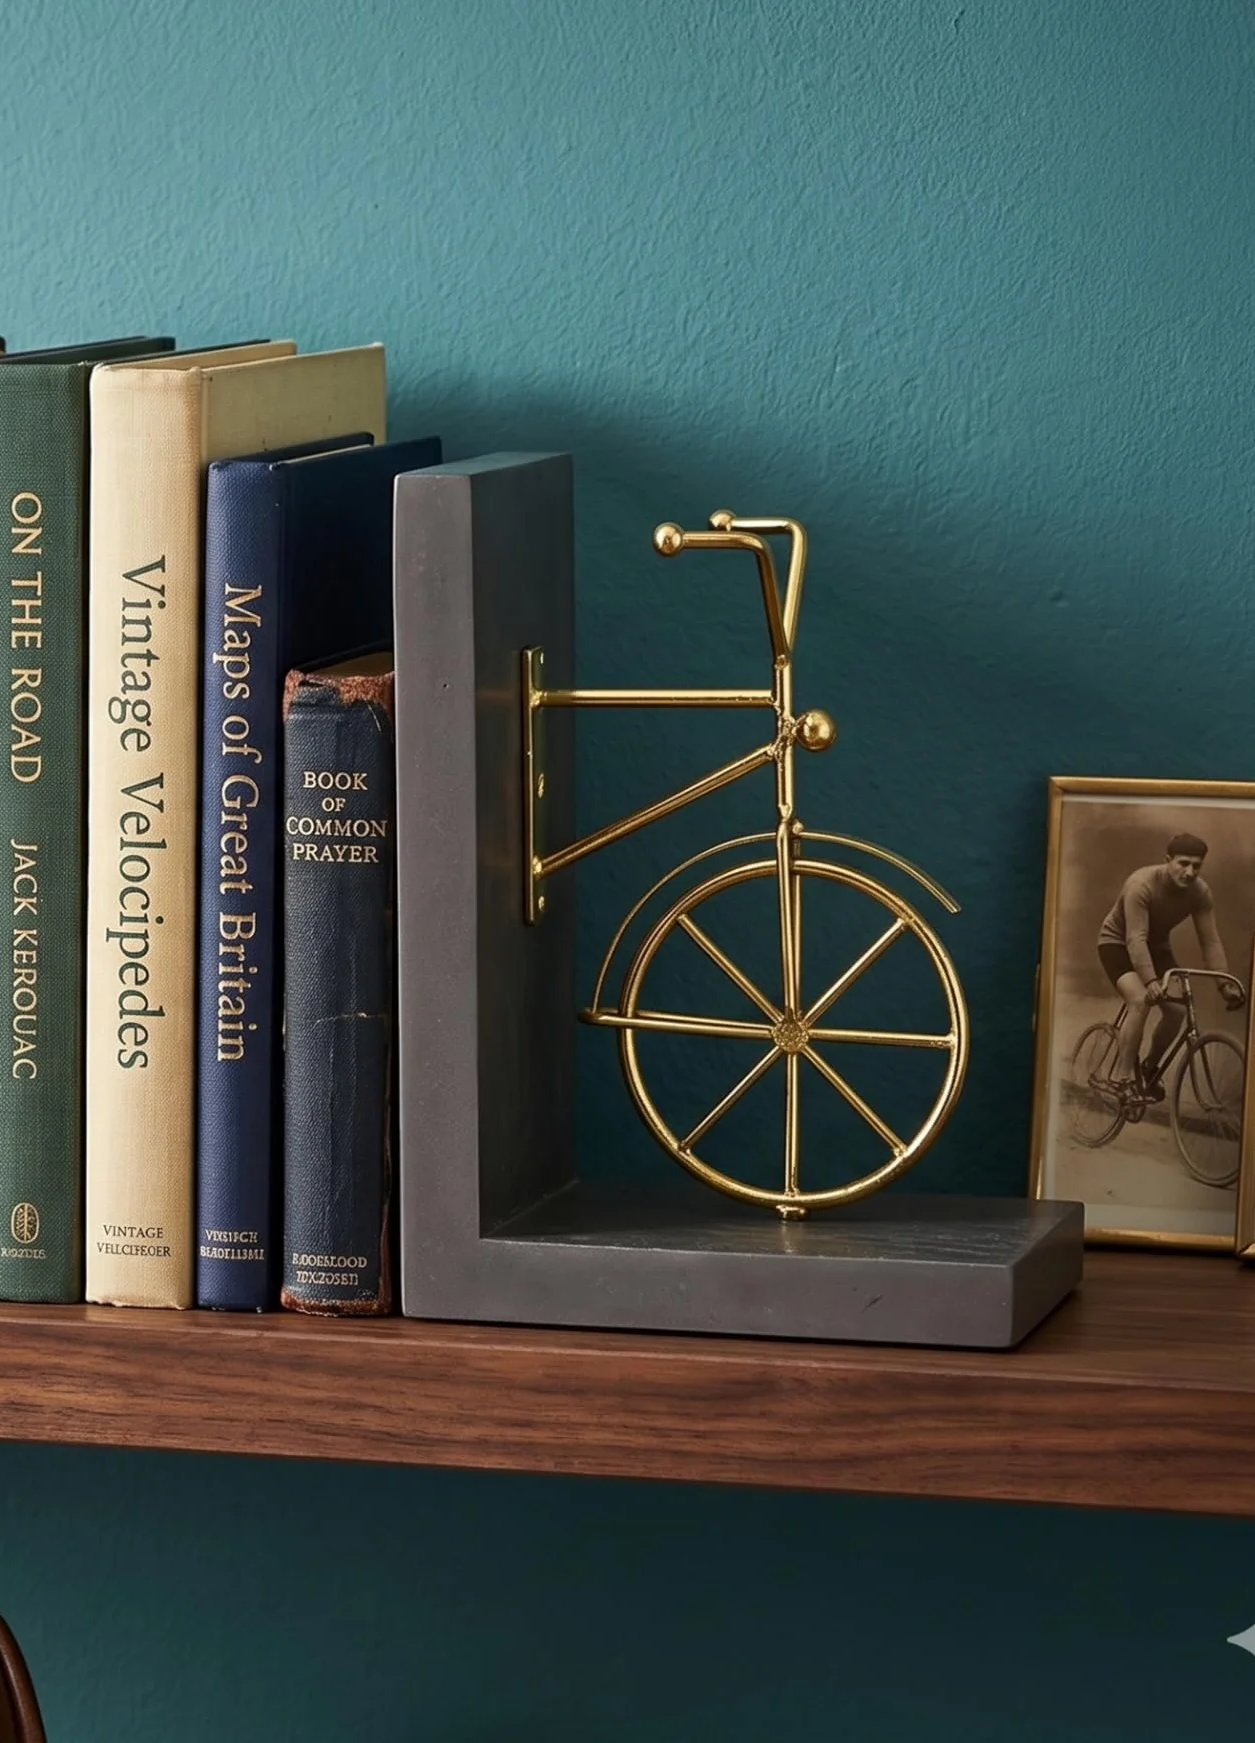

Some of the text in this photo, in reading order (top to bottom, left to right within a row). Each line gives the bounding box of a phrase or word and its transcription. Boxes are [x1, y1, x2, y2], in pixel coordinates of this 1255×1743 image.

[10, 491, 43, 783] ON THE ROAD
[302, 770, 369, 791] BOOK
[105, 554, 168, 1069] Vintage Velocipedes
[321, 796, 347, 812] OF
[212, 582, 263, 1062] Maps of Great Britain
[285, 815, 388, 838] COMMON
[292, 842, 380, 863] PRAYER
[10, 838, 39, 1080] JACK KEROUAC
[102, 1224, 165, 1239] VINTAGE
